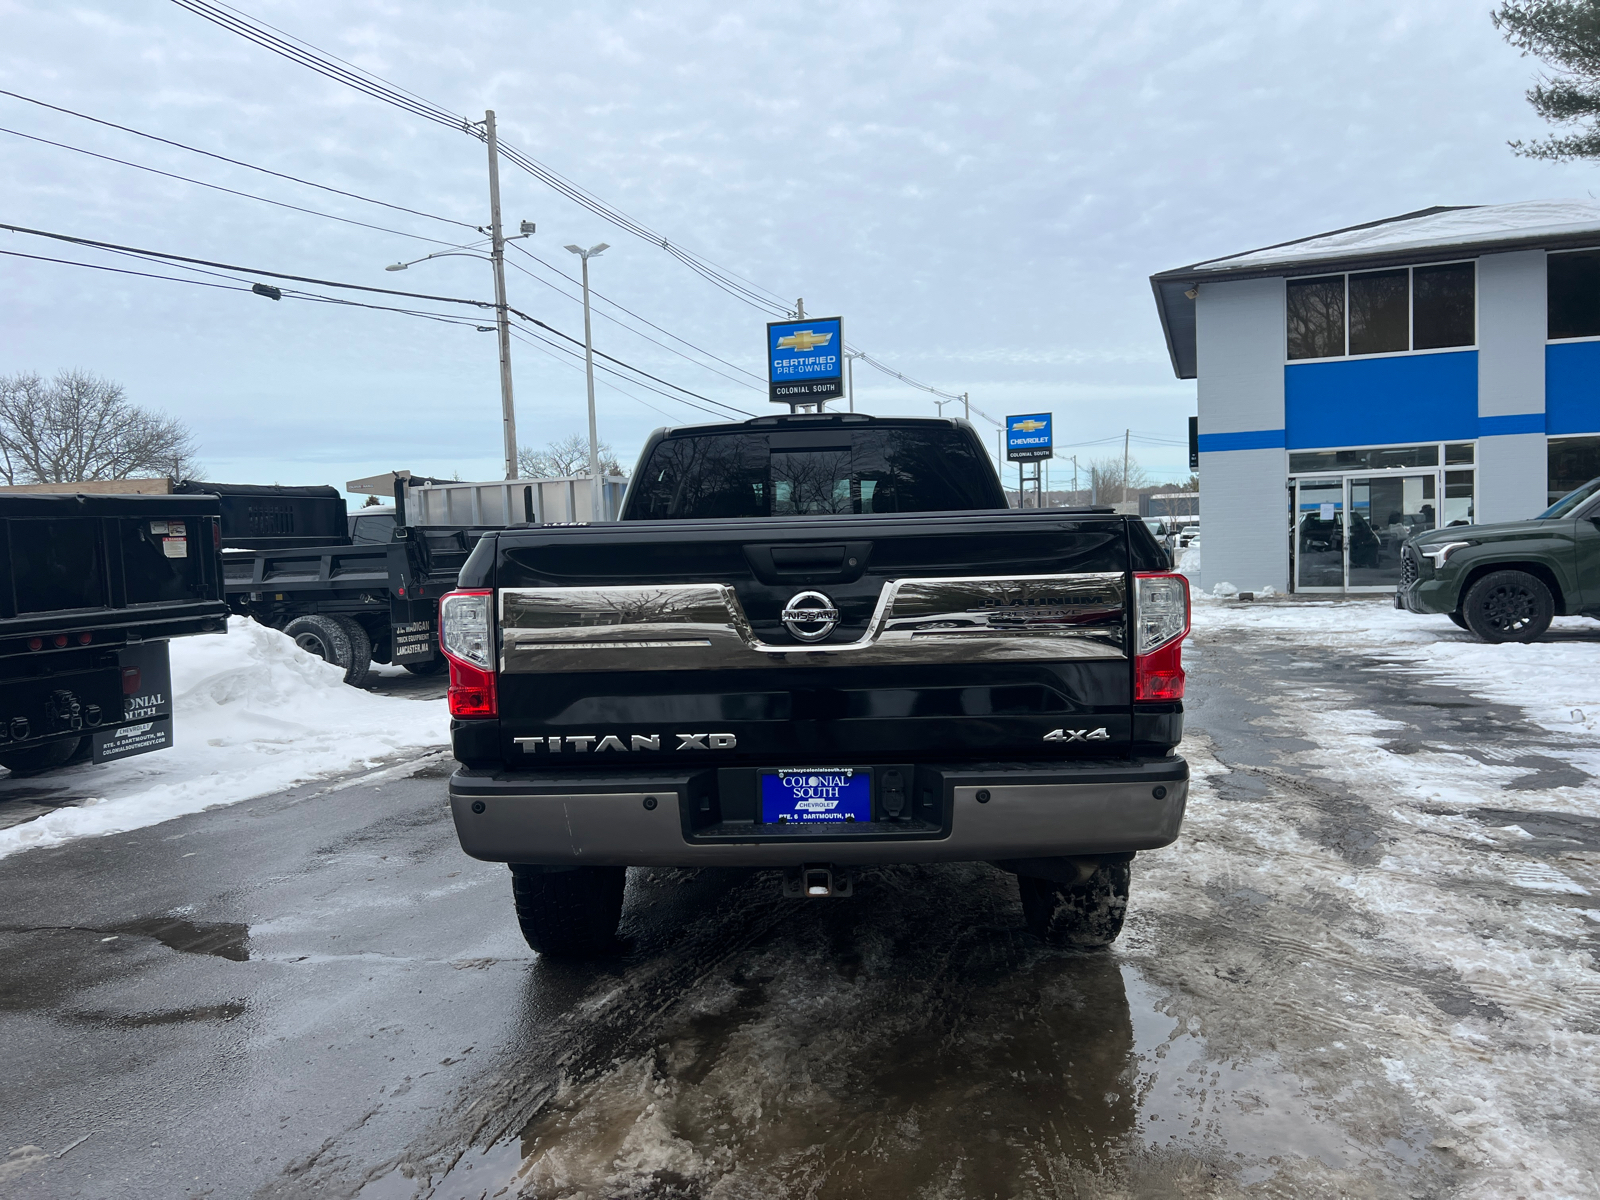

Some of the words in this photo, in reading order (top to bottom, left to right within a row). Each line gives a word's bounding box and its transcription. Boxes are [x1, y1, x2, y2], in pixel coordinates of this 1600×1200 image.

[774, 355, 836, 368] CERTIFIED
[777, 363, 833, 375] PRE-OWNED
[776, 387, 810, 395] COLONIAL
[813, 384, 835, 392] SOUTH
[1010, 436, 1049, 446] CHEVROLET
[977, 596, 1103, 607] PLATINUM
[788, 610, 833, 620] NISSAN
[1001, 609, 1082, 617] RESERVE
[121, 733, 156, 745] DARTMOUTH,
[513, 734, 660, 753] TITAN
[676, 733, 737, 751] XD
[103, 738, 165, 755] COLONIALSOUTHCHEVY.COM
[783, 776, 850, 788] COLONIAL
[793, 787, 839, 798] SOUTH
